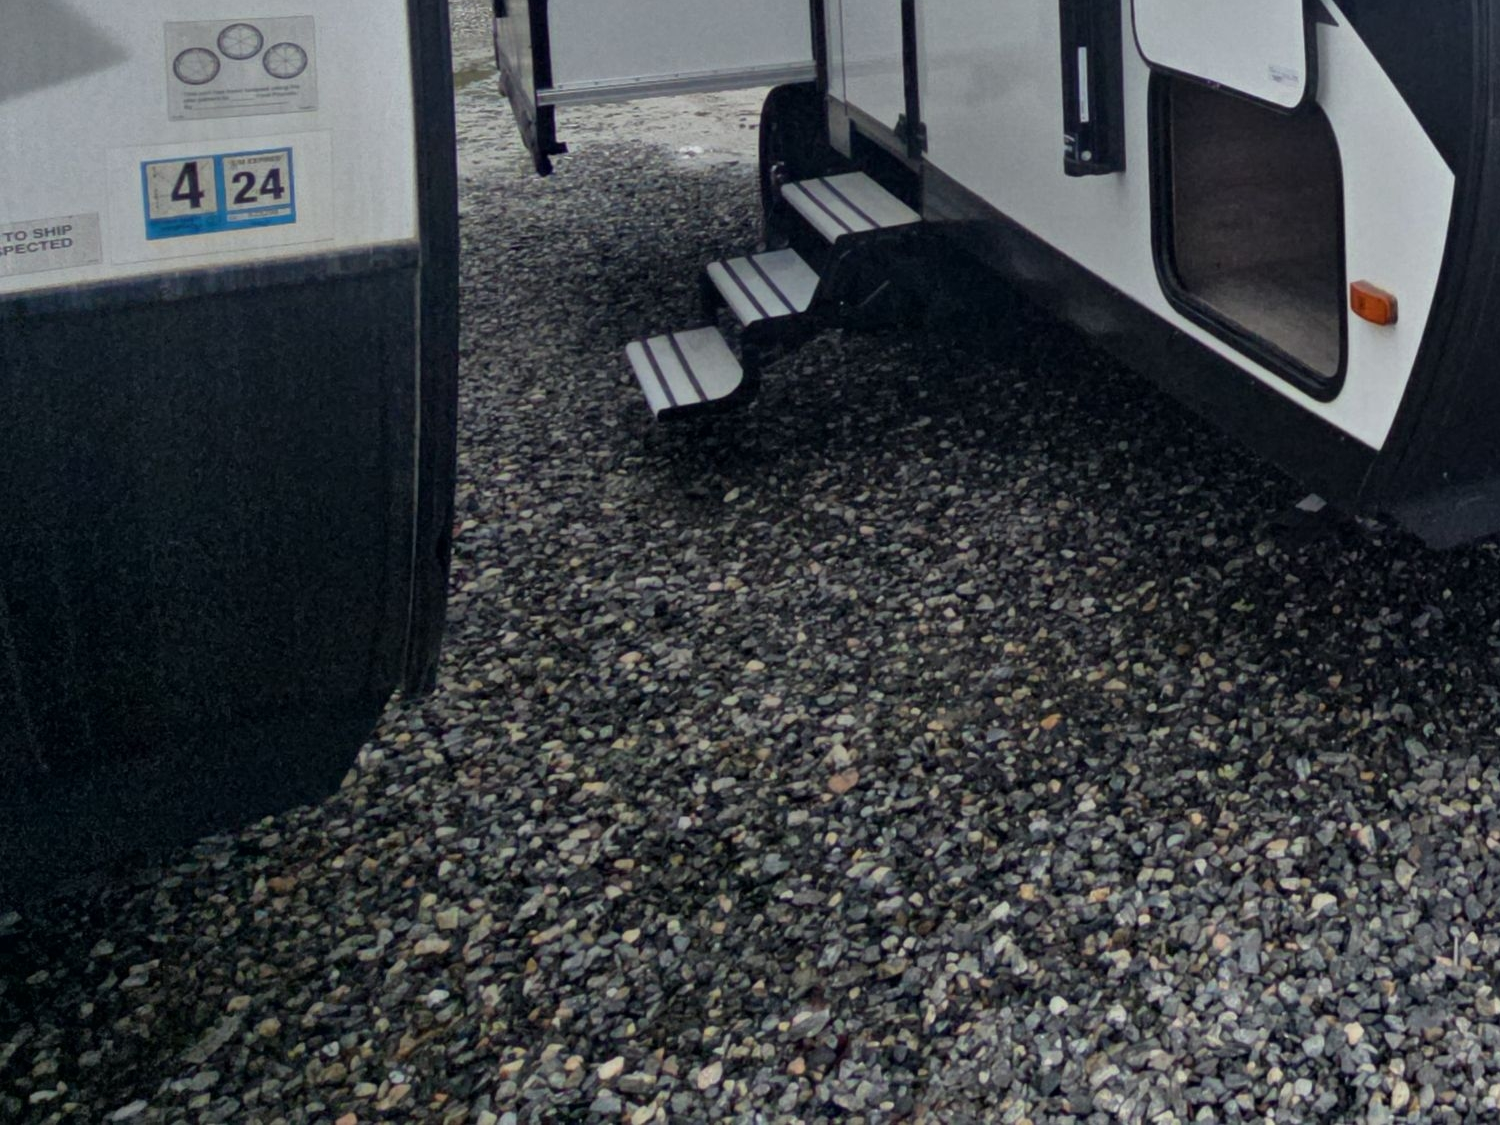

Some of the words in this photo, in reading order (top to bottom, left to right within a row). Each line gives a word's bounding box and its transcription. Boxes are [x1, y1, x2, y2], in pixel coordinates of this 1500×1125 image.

[171, 161, 205, 209] 4
[231, 167, 285, 205] 24
[2, 231, 28, 243] TO
[33, 224, 73, 239] SHIP
